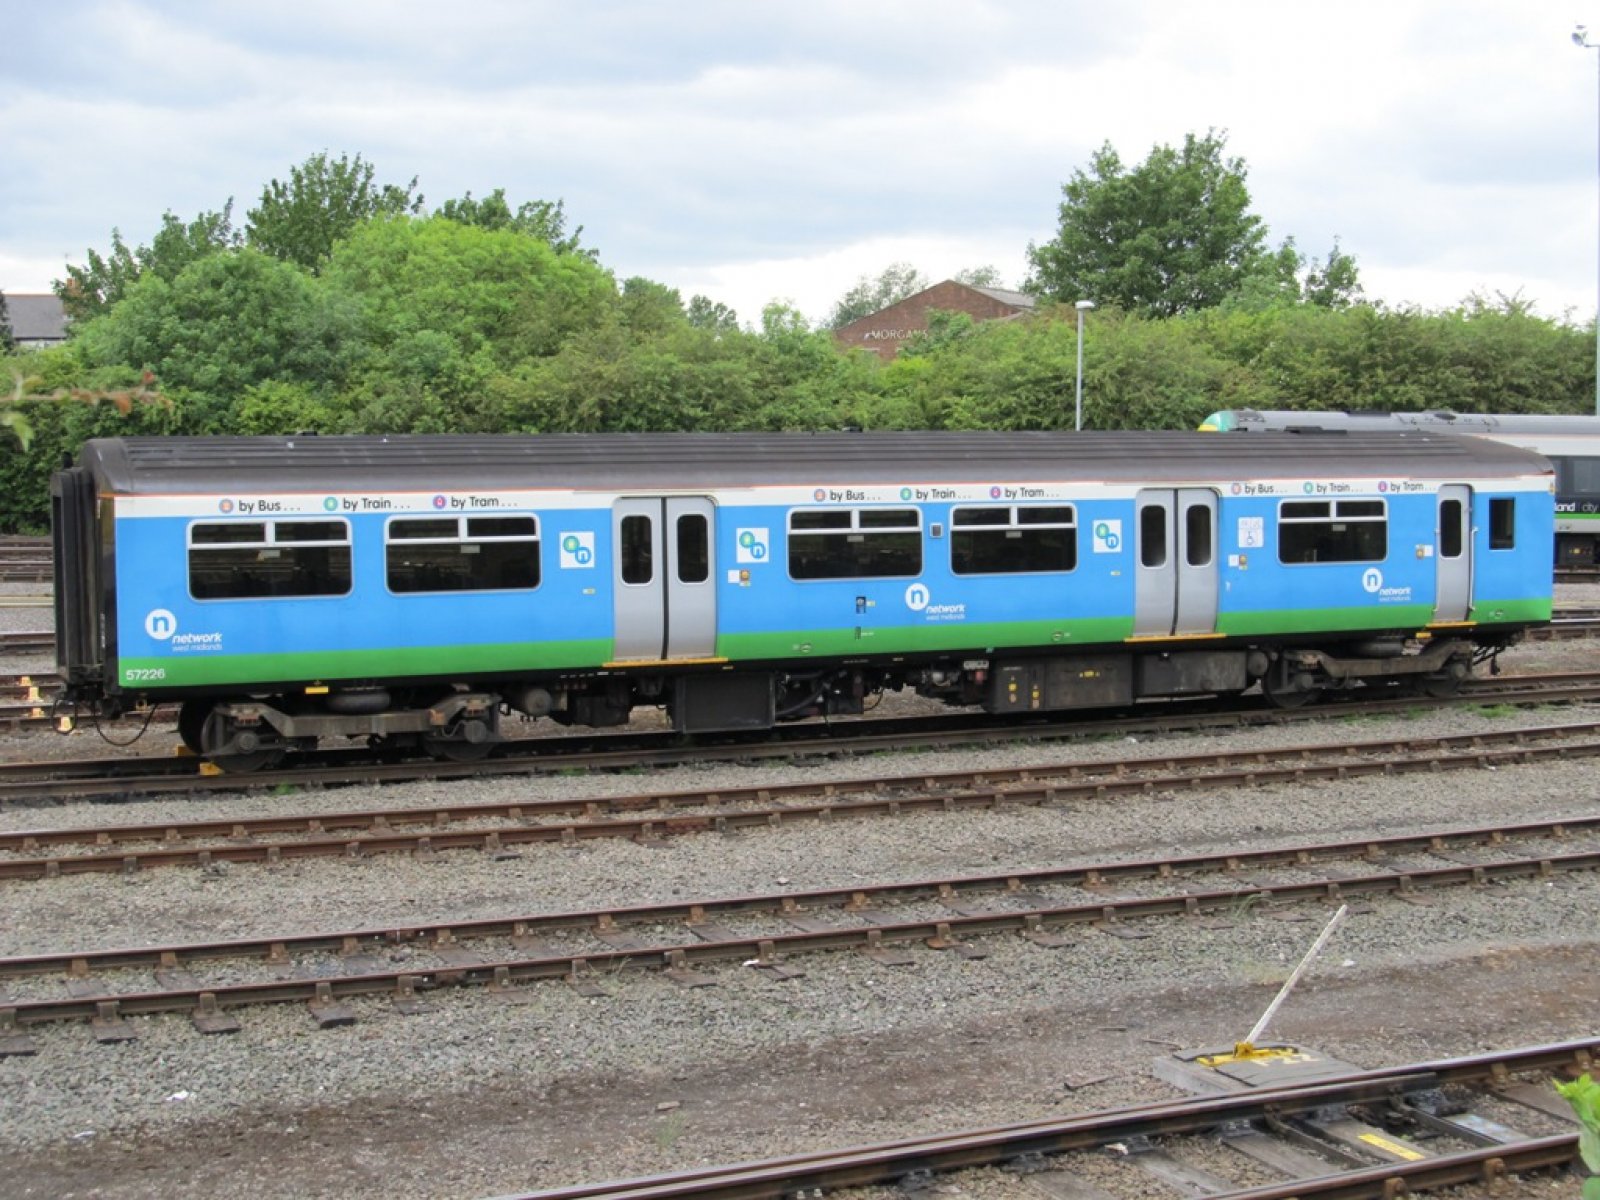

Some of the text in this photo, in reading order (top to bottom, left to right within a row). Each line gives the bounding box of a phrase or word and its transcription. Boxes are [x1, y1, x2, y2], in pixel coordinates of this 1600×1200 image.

[1245, 484, 1256, 495] by
[1316, 483, 1327, 494] by
[1390, 481, 1401, 493] by
[830, 490, 843, 502] by
[916, 489, 929, 500] by
[1005, 488, 1018, 499] by
[238, 500, 254, 512] by
[343, 496, 358, 511] by
[451, 496, 466, 509] by
[926, 604, 965, 614] network
[172, 632, 223, 645] network
[126, 668, 166, 681] 57226
